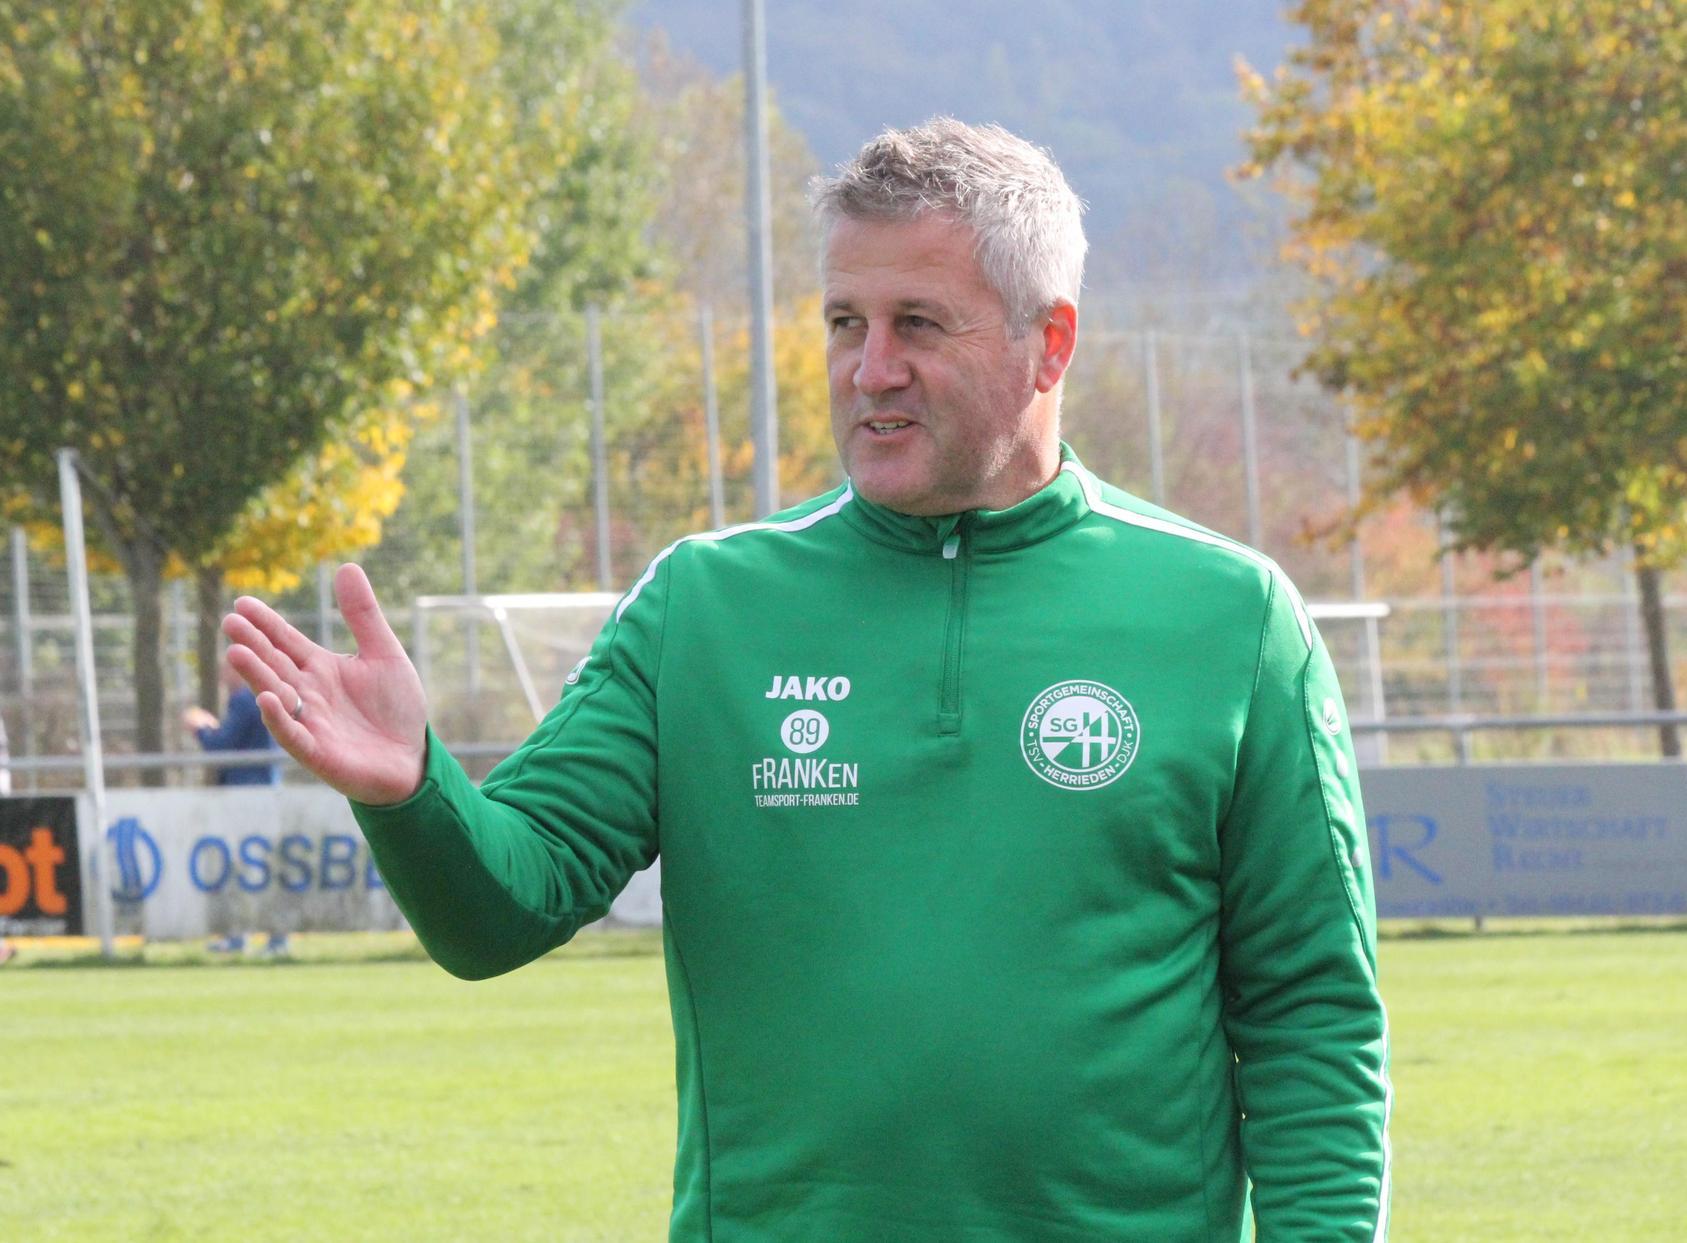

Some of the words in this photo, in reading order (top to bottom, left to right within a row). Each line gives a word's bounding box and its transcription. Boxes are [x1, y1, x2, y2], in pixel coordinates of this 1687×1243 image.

[765, 675, 851, 701] JAKO
[1028, 685, 1134, 732] SPORTGEMEINSCHAFT
[789, 717, 821, 745] 89
[1050, 717, 1078, 733] SG
[752, 758, 858, 789] FRANKEN
[754, 793, 860, 808] TEAMSPORT-FRANKEN.DE
